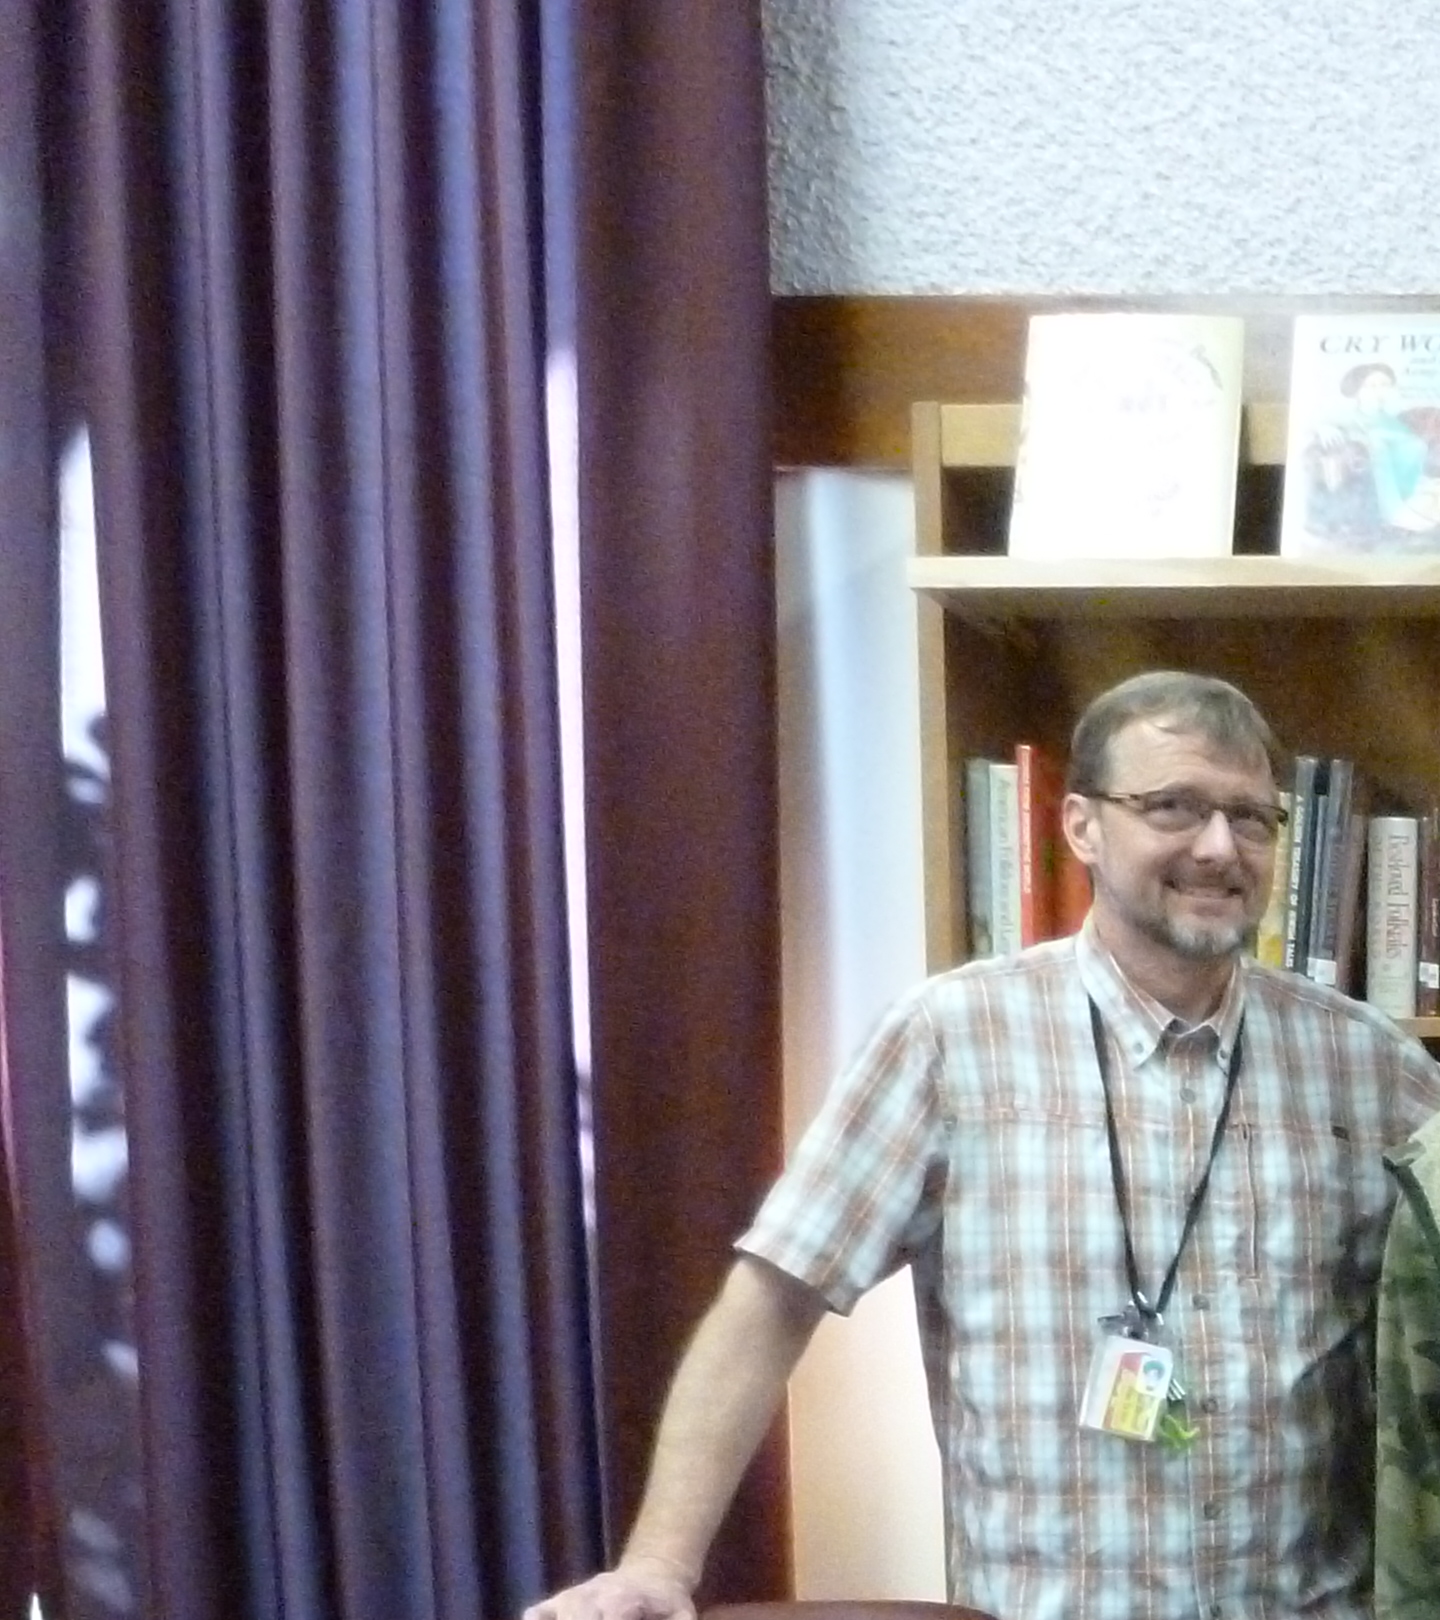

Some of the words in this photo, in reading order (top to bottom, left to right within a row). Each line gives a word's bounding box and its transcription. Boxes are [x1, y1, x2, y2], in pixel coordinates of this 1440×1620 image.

[1319, 334, 1390, 353] CRY
[1290, 893, 1298, 906] OF
[1386, 902, 1409, 960] Folktales
[1285, 943, 1295, 968] TALES
